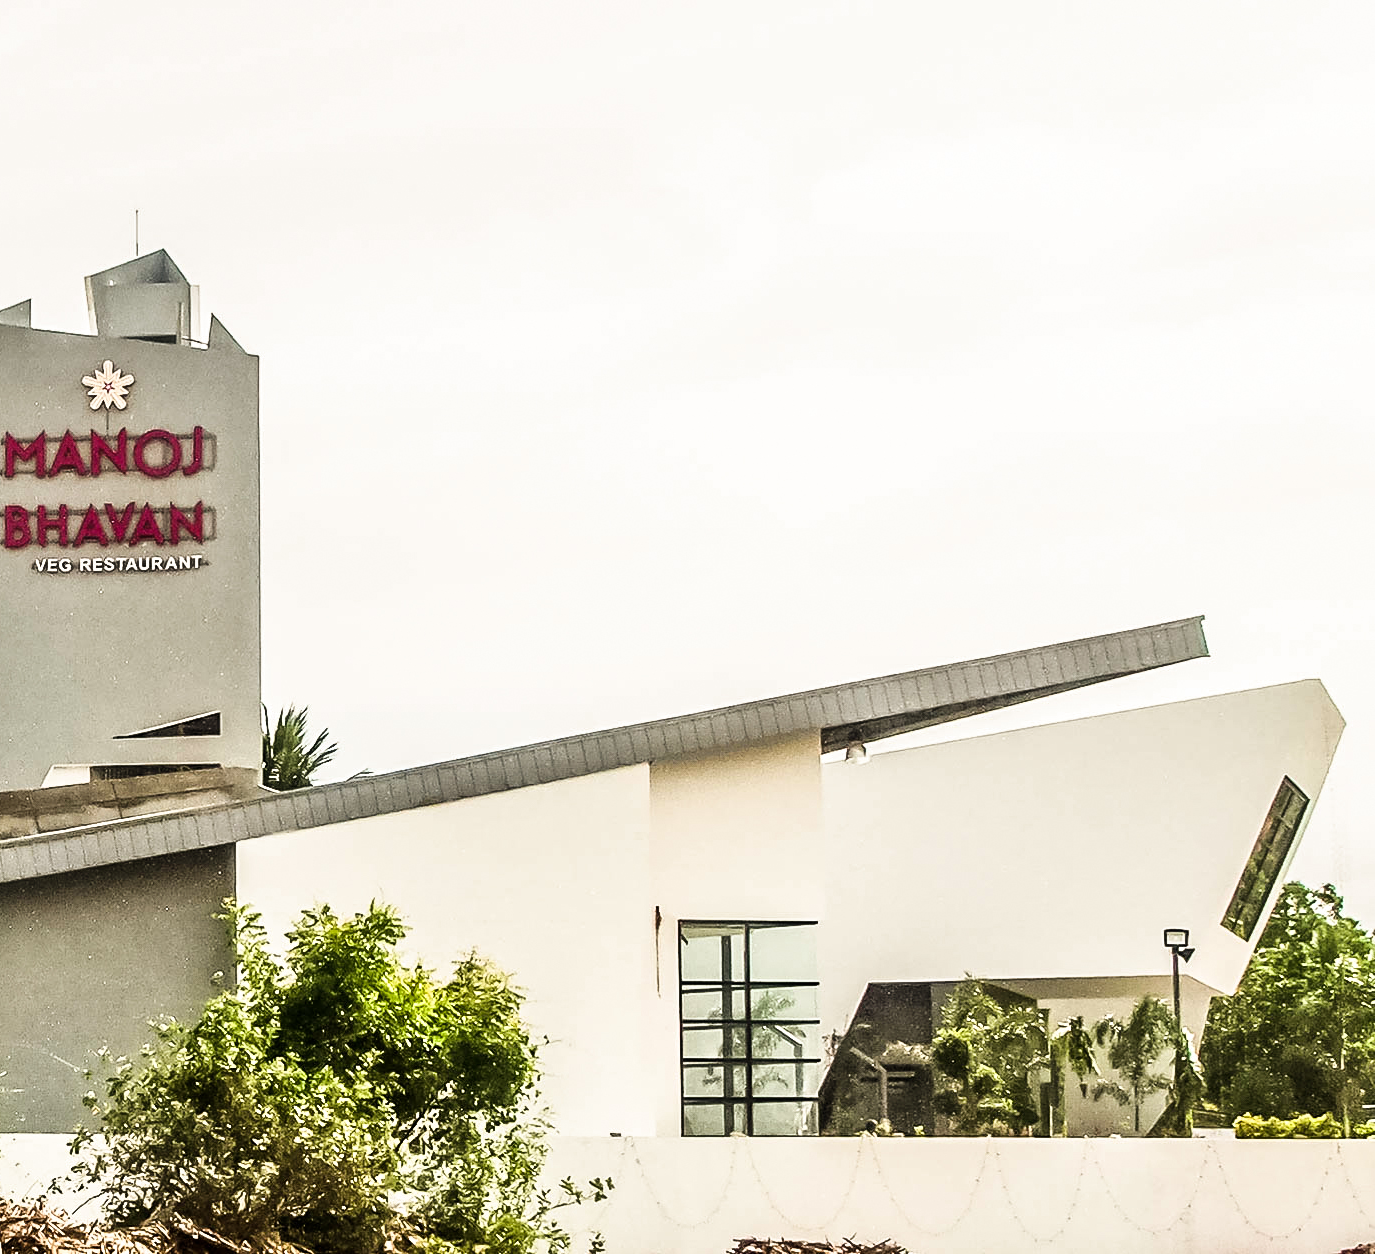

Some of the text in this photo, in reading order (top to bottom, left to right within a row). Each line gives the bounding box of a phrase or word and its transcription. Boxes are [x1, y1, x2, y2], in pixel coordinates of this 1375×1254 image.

[4, 426, 204, 478] MANOJ
[4, 500, 204, 549] BHAVAN
[35, 555, 202, 572] VEG RESTAURANT
